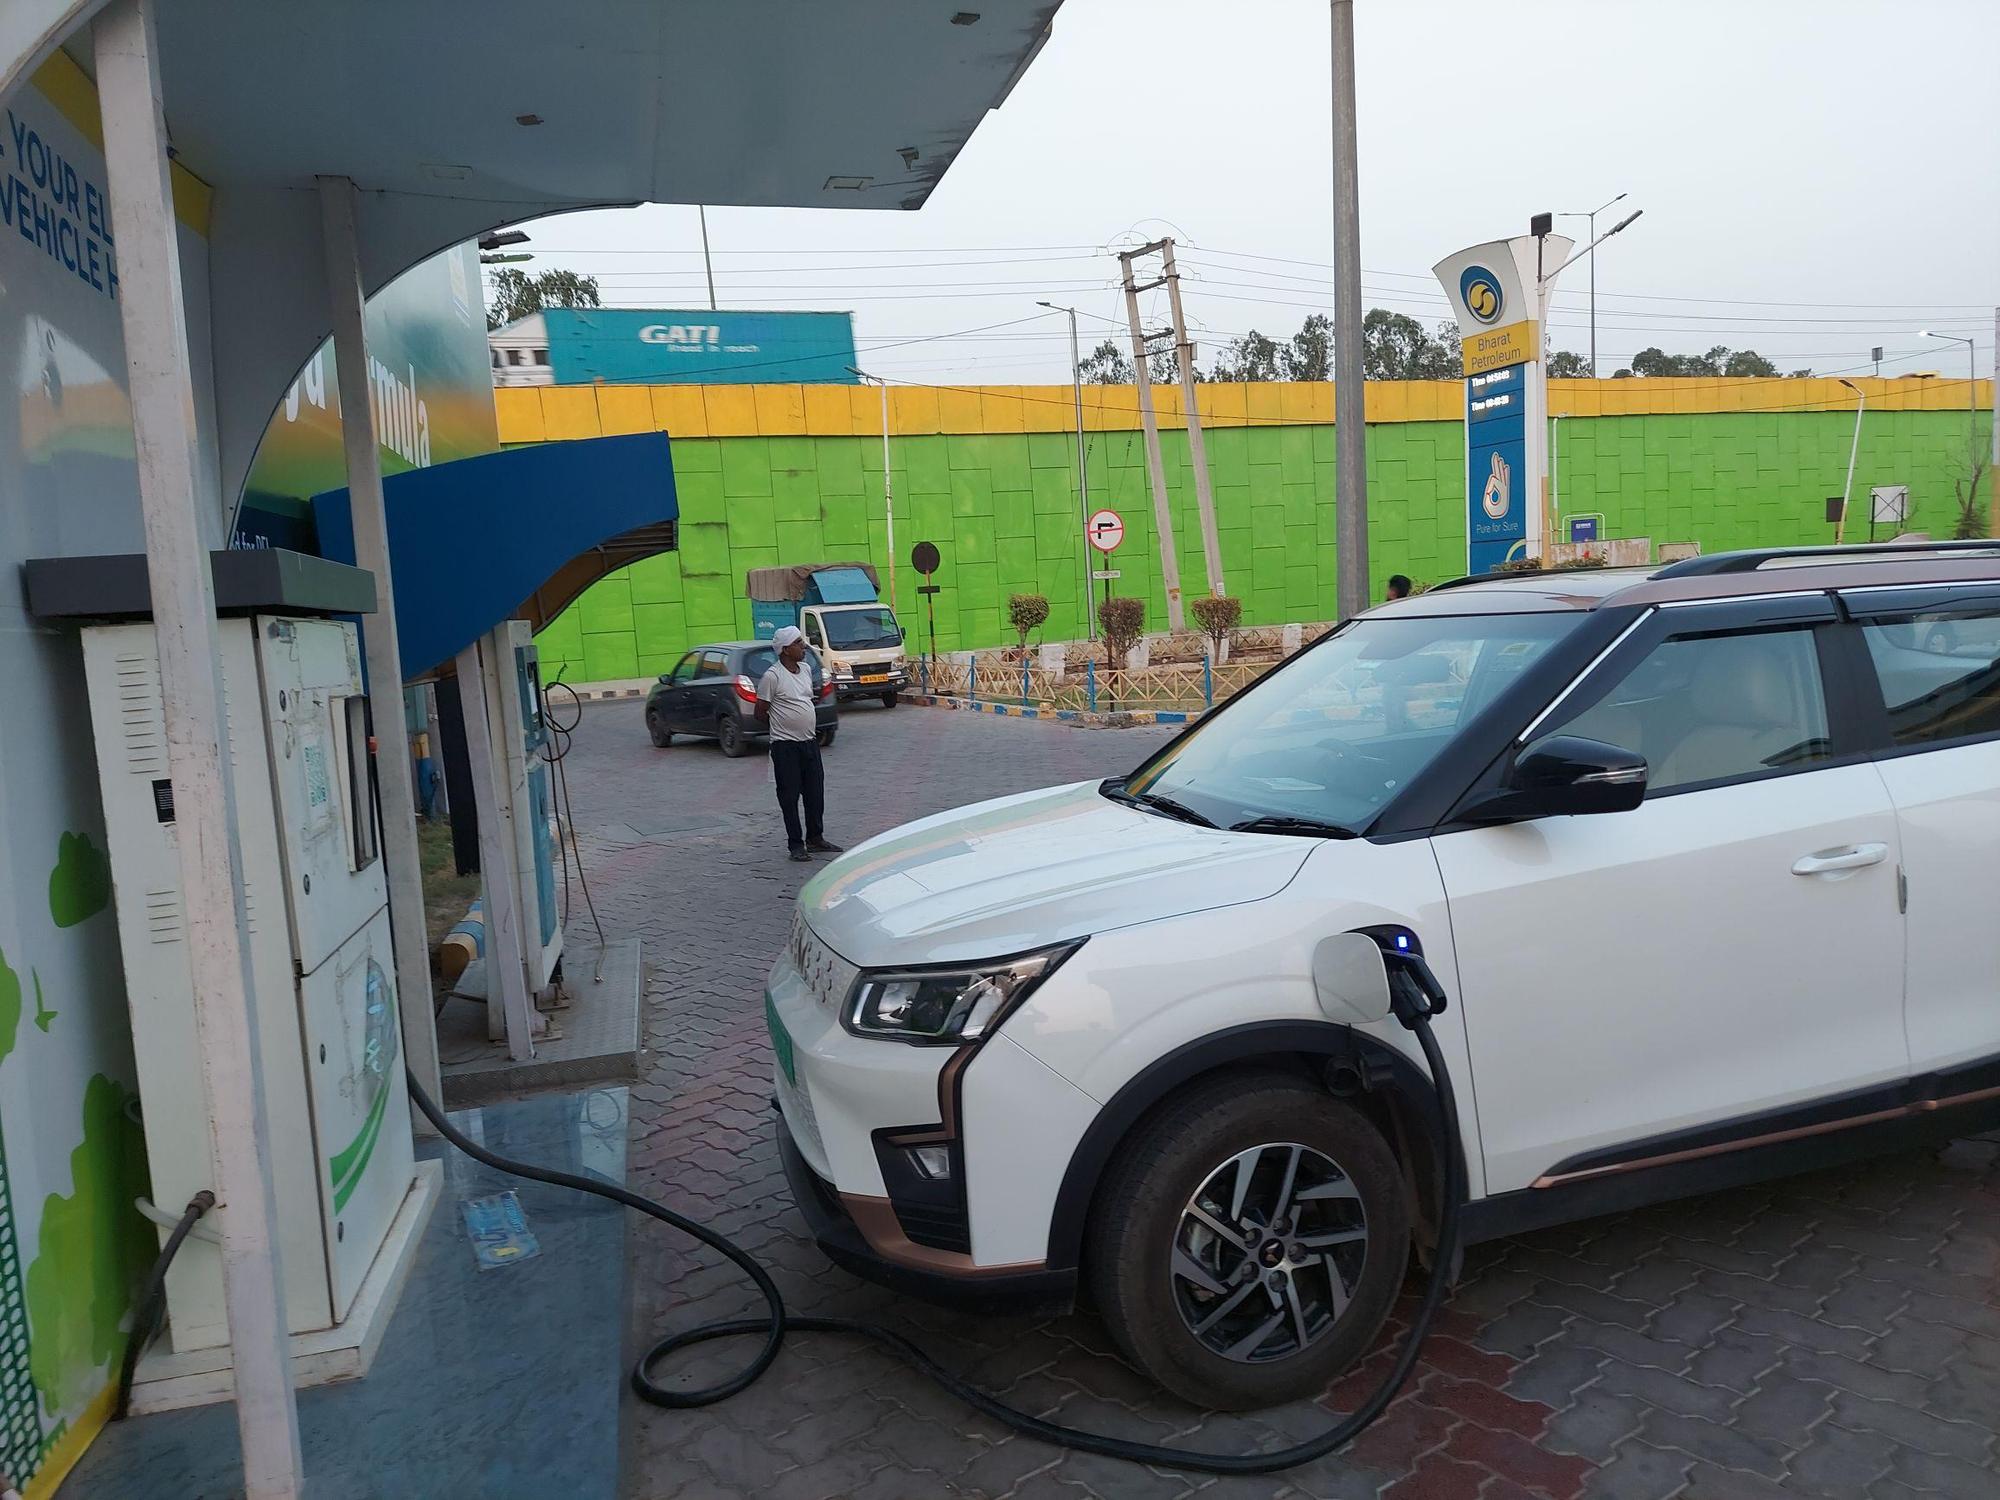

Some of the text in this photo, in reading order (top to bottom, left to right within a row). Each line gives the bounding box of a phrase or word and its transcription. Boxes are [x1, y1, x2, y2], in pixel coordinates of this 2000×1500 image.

[8, 107, 82, 222] YOUR
[0, 172, 103, 293] VEHICLE
[638, 324, 721, 344] GATI
[1477, 332, 1512, 352] Bharat
[1471, 347, 1522, 370] Petroleum
[1476, 521, 1519, 534] Pure for Sure
